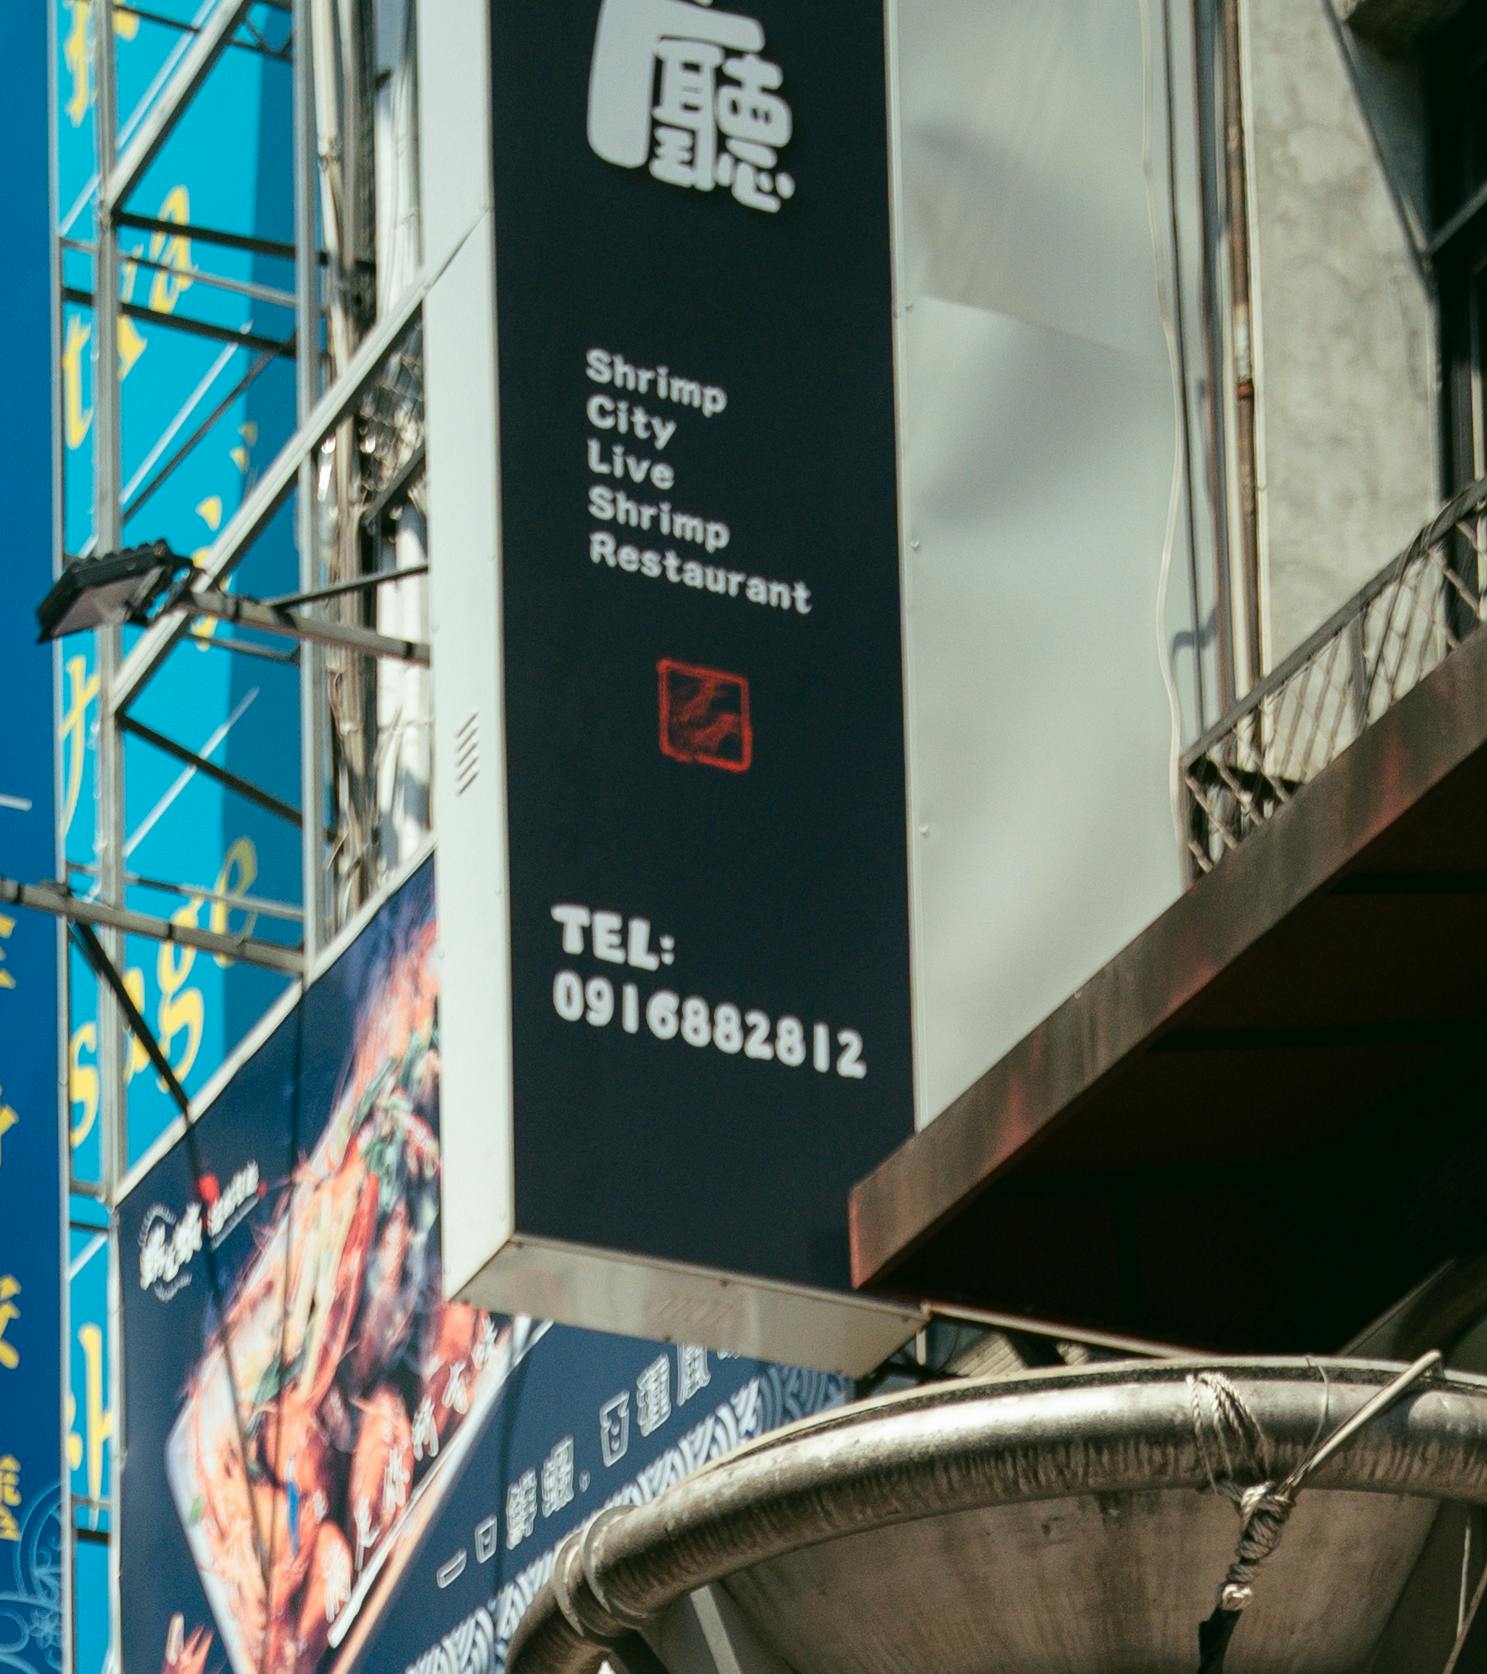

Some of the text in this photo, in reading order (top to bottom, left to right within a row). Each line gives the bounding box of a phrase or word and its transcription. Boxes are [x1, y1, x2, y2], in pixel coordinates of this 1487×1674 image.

[585, 348, 728, 418] Shrimp
[585, 394, 677, 451] City
[587, 437, 675, 491] Live
[588, 484, 731, 553] Shrimp
[589, 530, 813, 615] Restaurant
[551, 904, 676, 972] TEL:
[552, 967, 867, 1079] 0916882812
